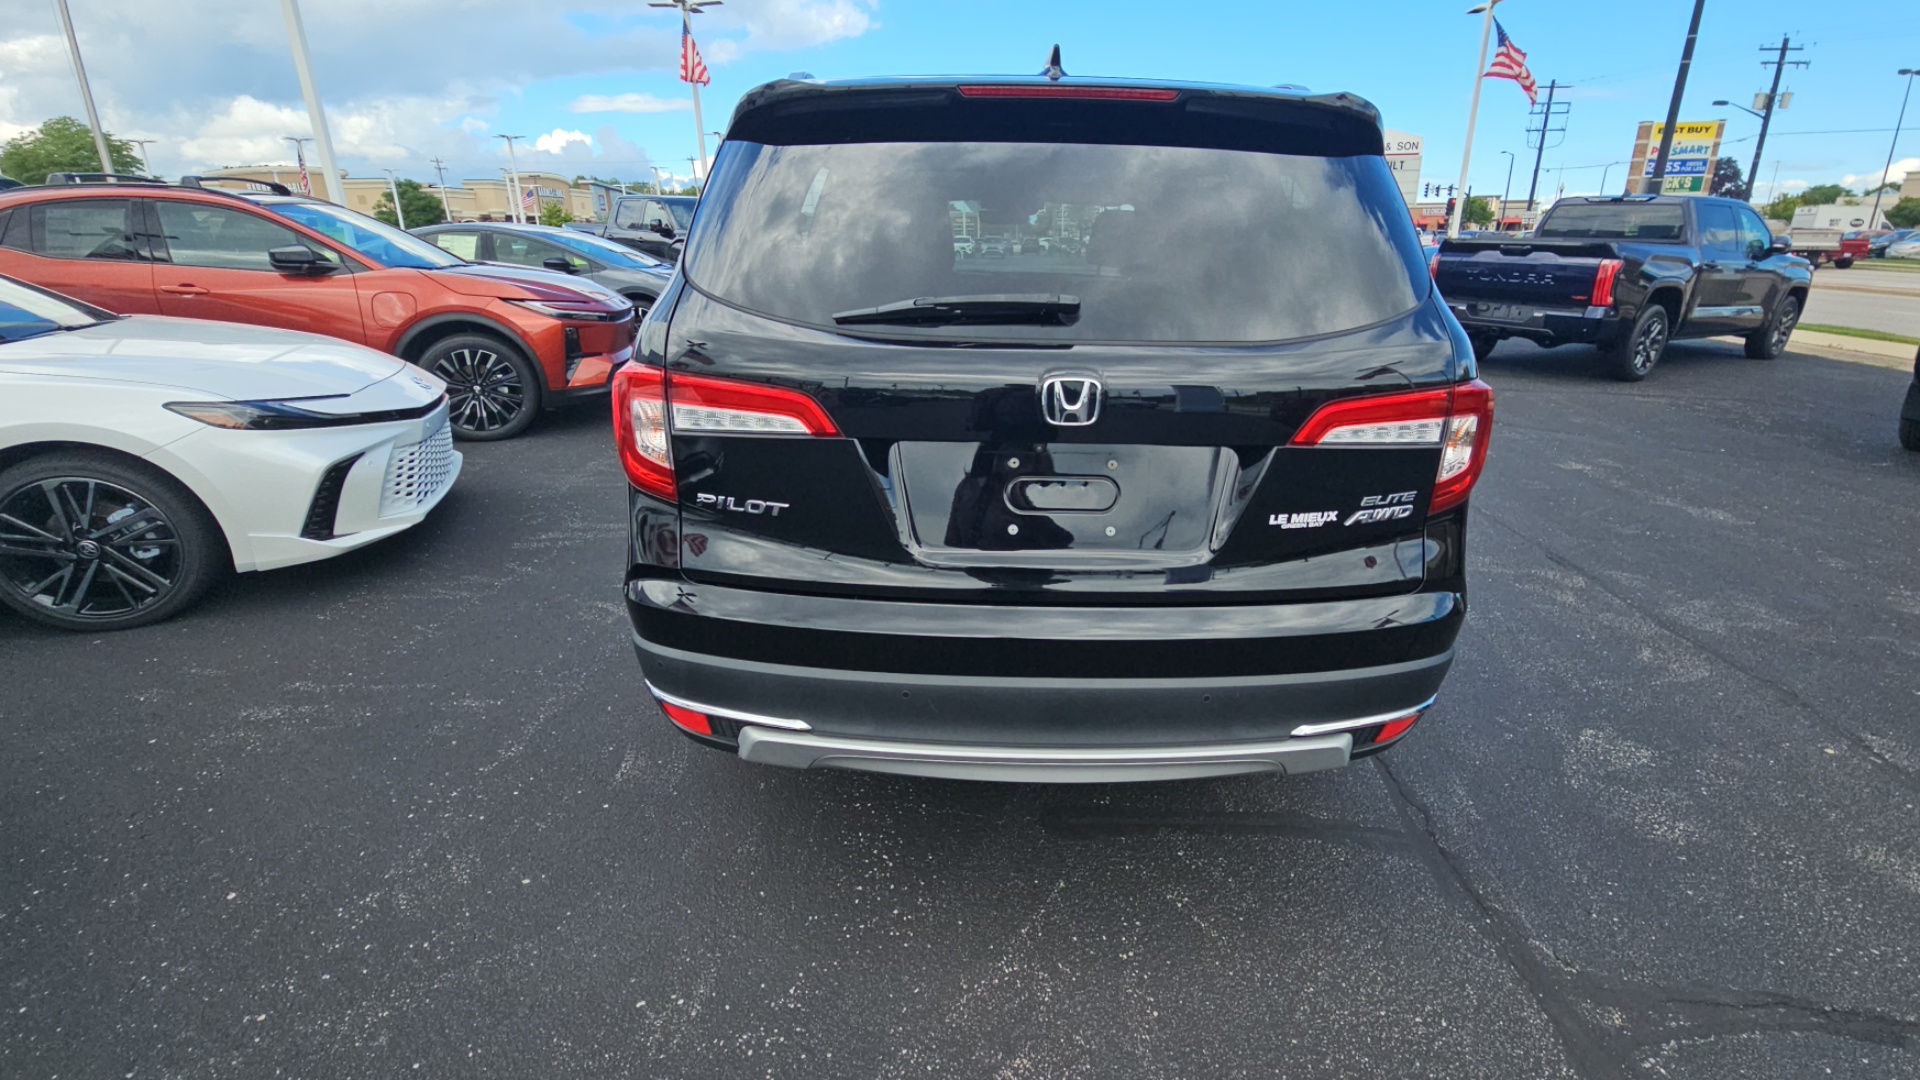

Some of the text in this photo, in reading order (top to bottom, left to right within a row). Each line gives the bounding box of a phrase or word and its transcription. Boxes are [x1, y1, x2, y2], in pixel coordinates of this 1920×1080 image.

[1657, 126, 1712, 134] BST BUY
[1397, 141, 1420, 151] SON
[1651, 145, 1710, 156] PSMART
[1645, 162, 1681, 173] RSS
[1360, 491, 1418, 507] ELITE
[696, 493, 790, 517] PILOT
[1269, 510, 1338, 525] LE MIEUX
[1344, 504, 1414, 527] AWD
[1280, 520, 1325, 529] GREEN BAY
